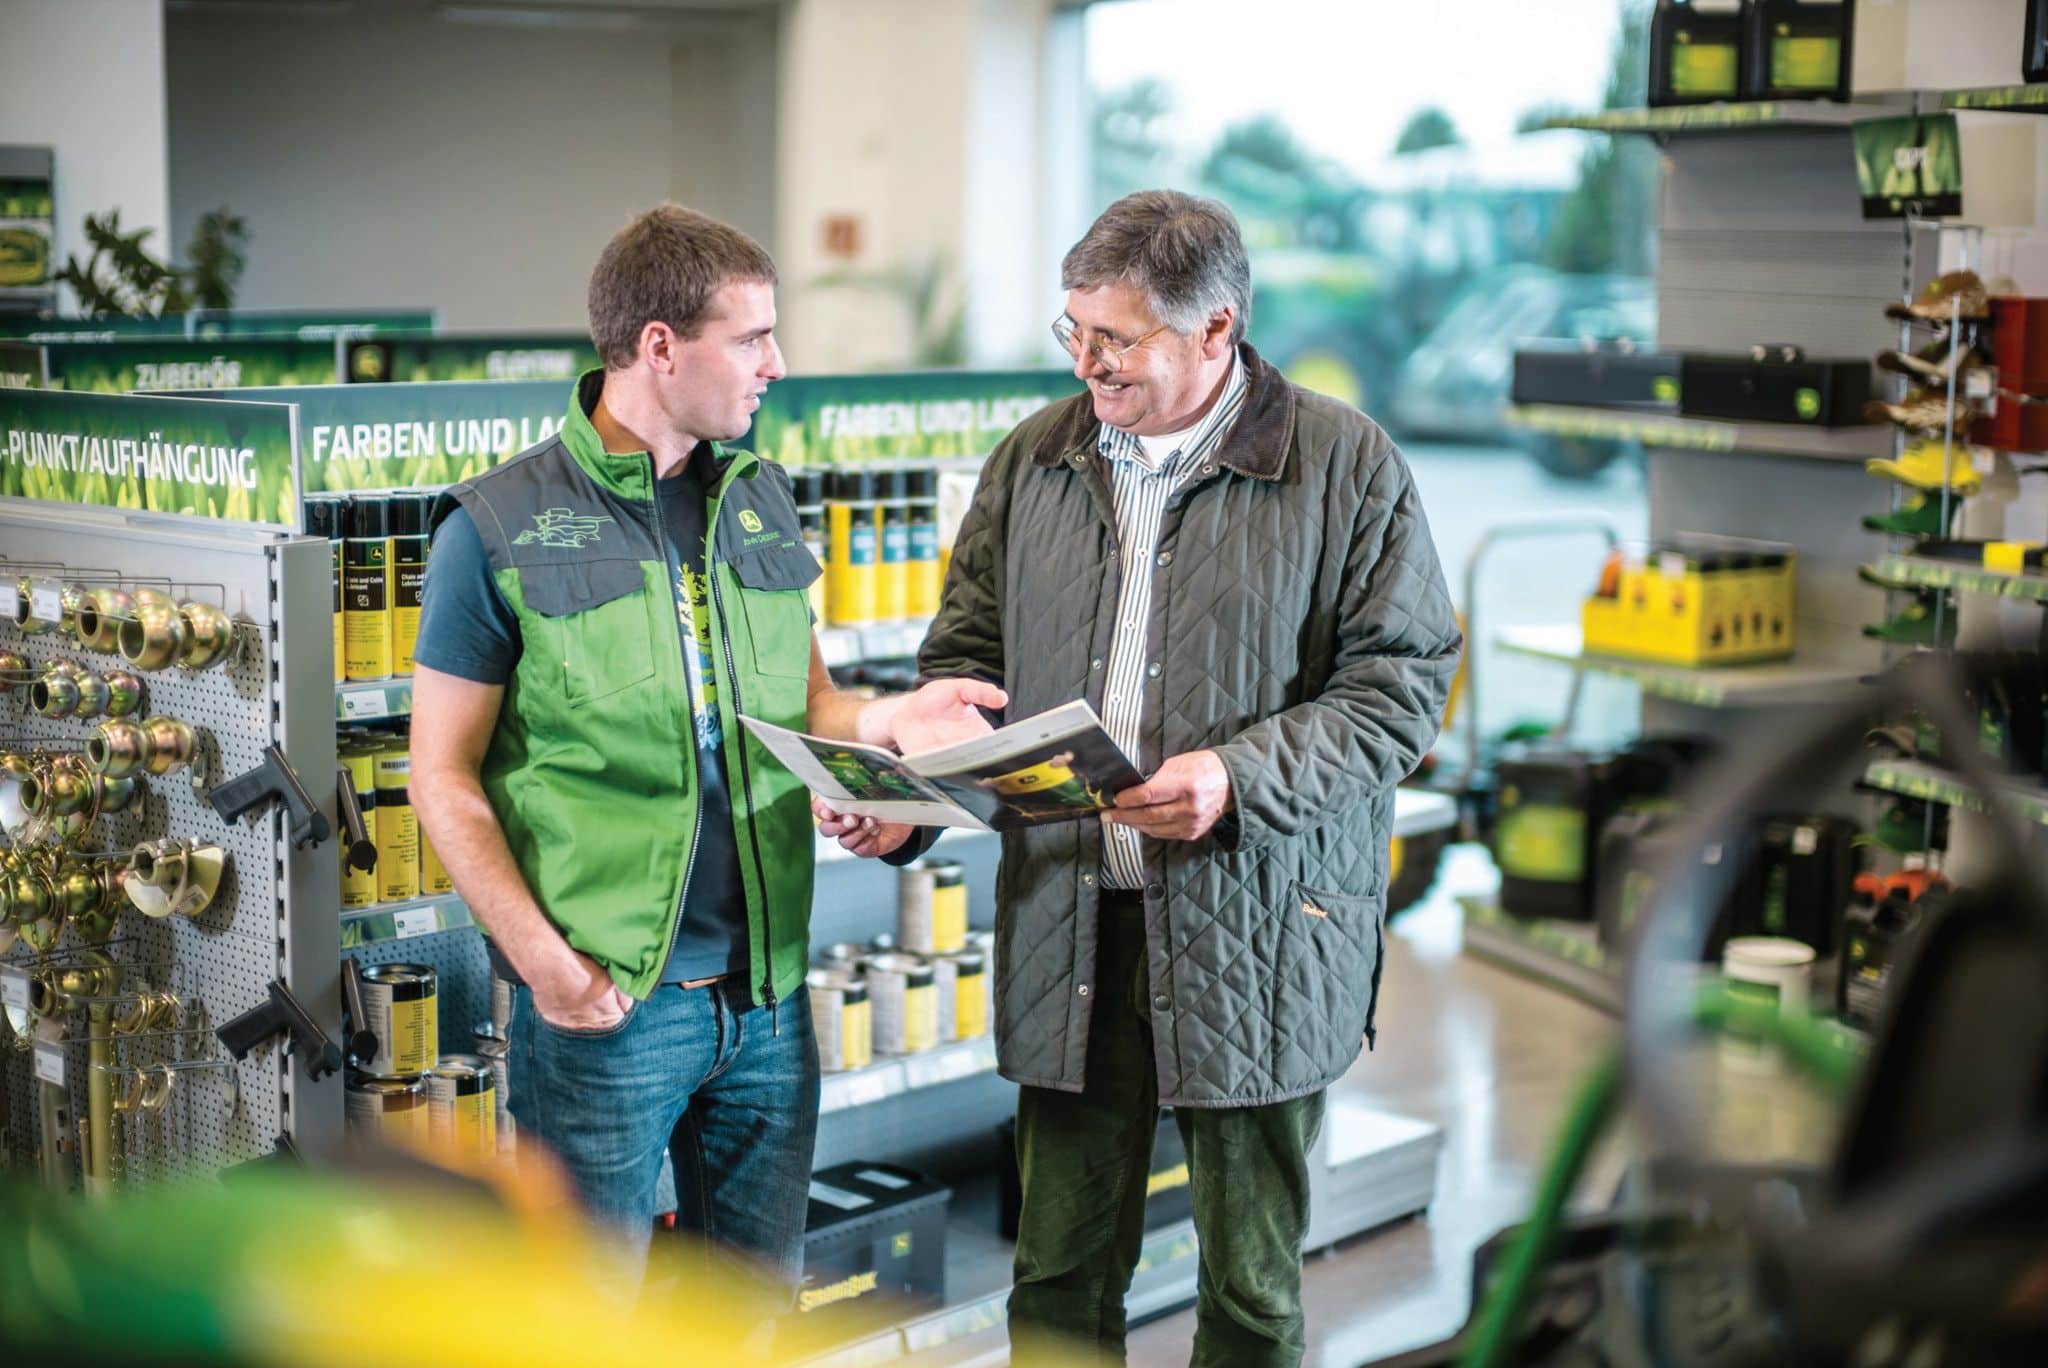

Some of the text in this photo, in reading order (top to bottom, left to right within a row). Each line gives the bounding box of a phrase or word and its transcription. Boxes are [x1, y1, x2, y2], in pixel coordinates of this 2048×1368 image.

[919, 400, 976, 434] UND
[312, 421, 435, 462] FARBEN
[444, 418, 511, 456] UND
